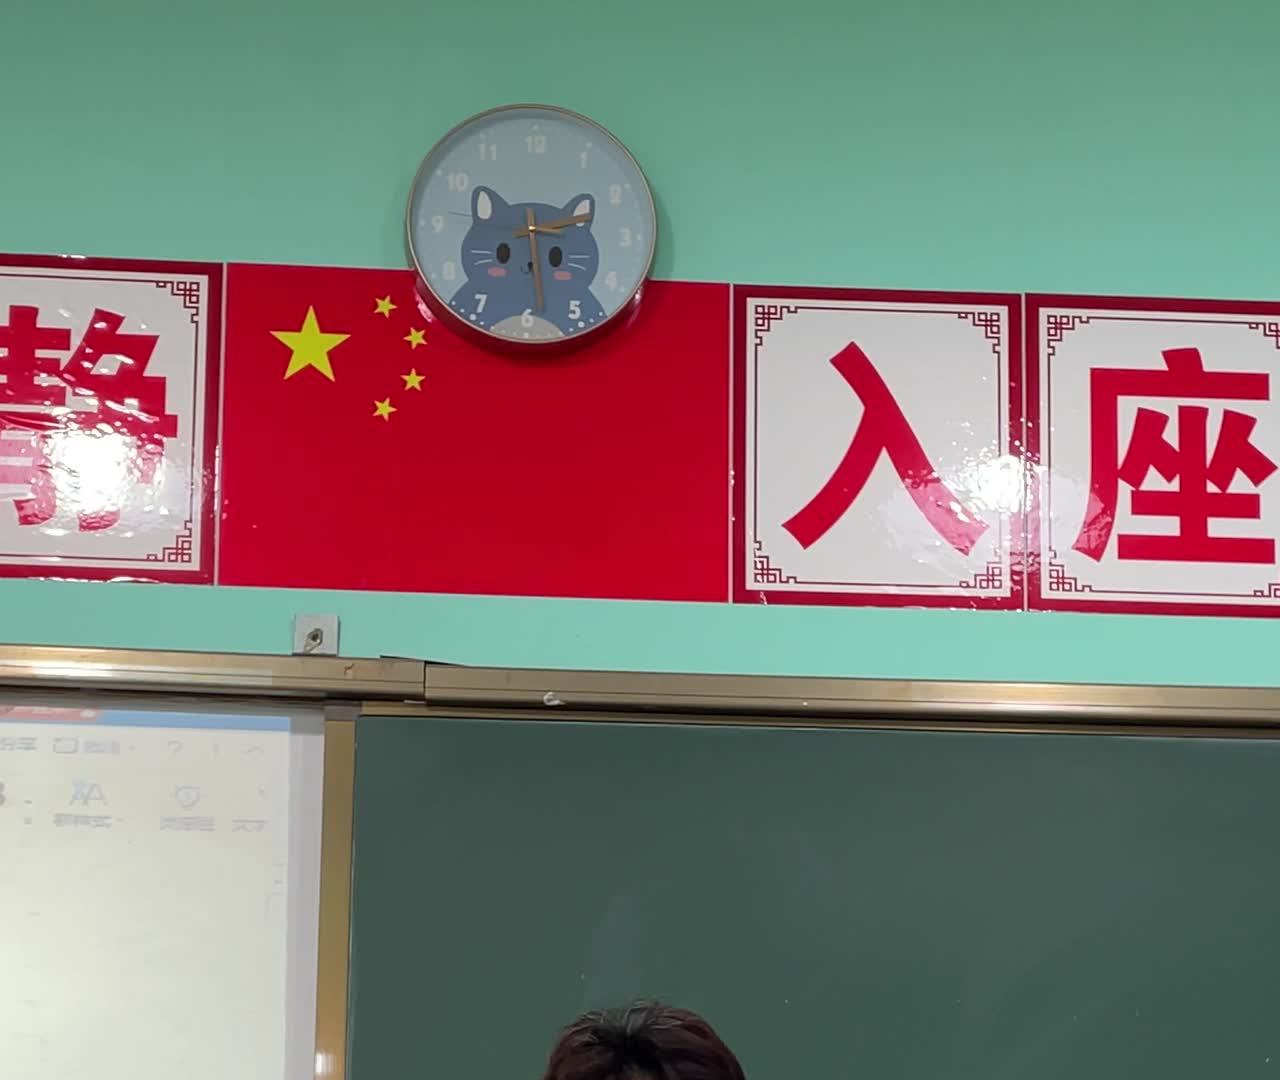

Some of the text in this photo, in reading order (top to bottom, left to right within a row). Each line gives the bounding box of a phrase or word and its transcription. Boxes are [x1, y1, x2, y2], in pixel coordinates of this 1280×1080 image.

[479, 143, 497, 161] 11
[525, 136, 547, 154] 12
[580, 151, 588, 169] 1
[448, 172, 468, 192] 10
[432, 214, 444, 233] 9
[619, 229, 632, 247] 3
[442, 262, 456, 281] 8
[474, 293, 488, 313] 7
[568, 300, 581, 319] 5
[521, 308, 534, 328] 6
